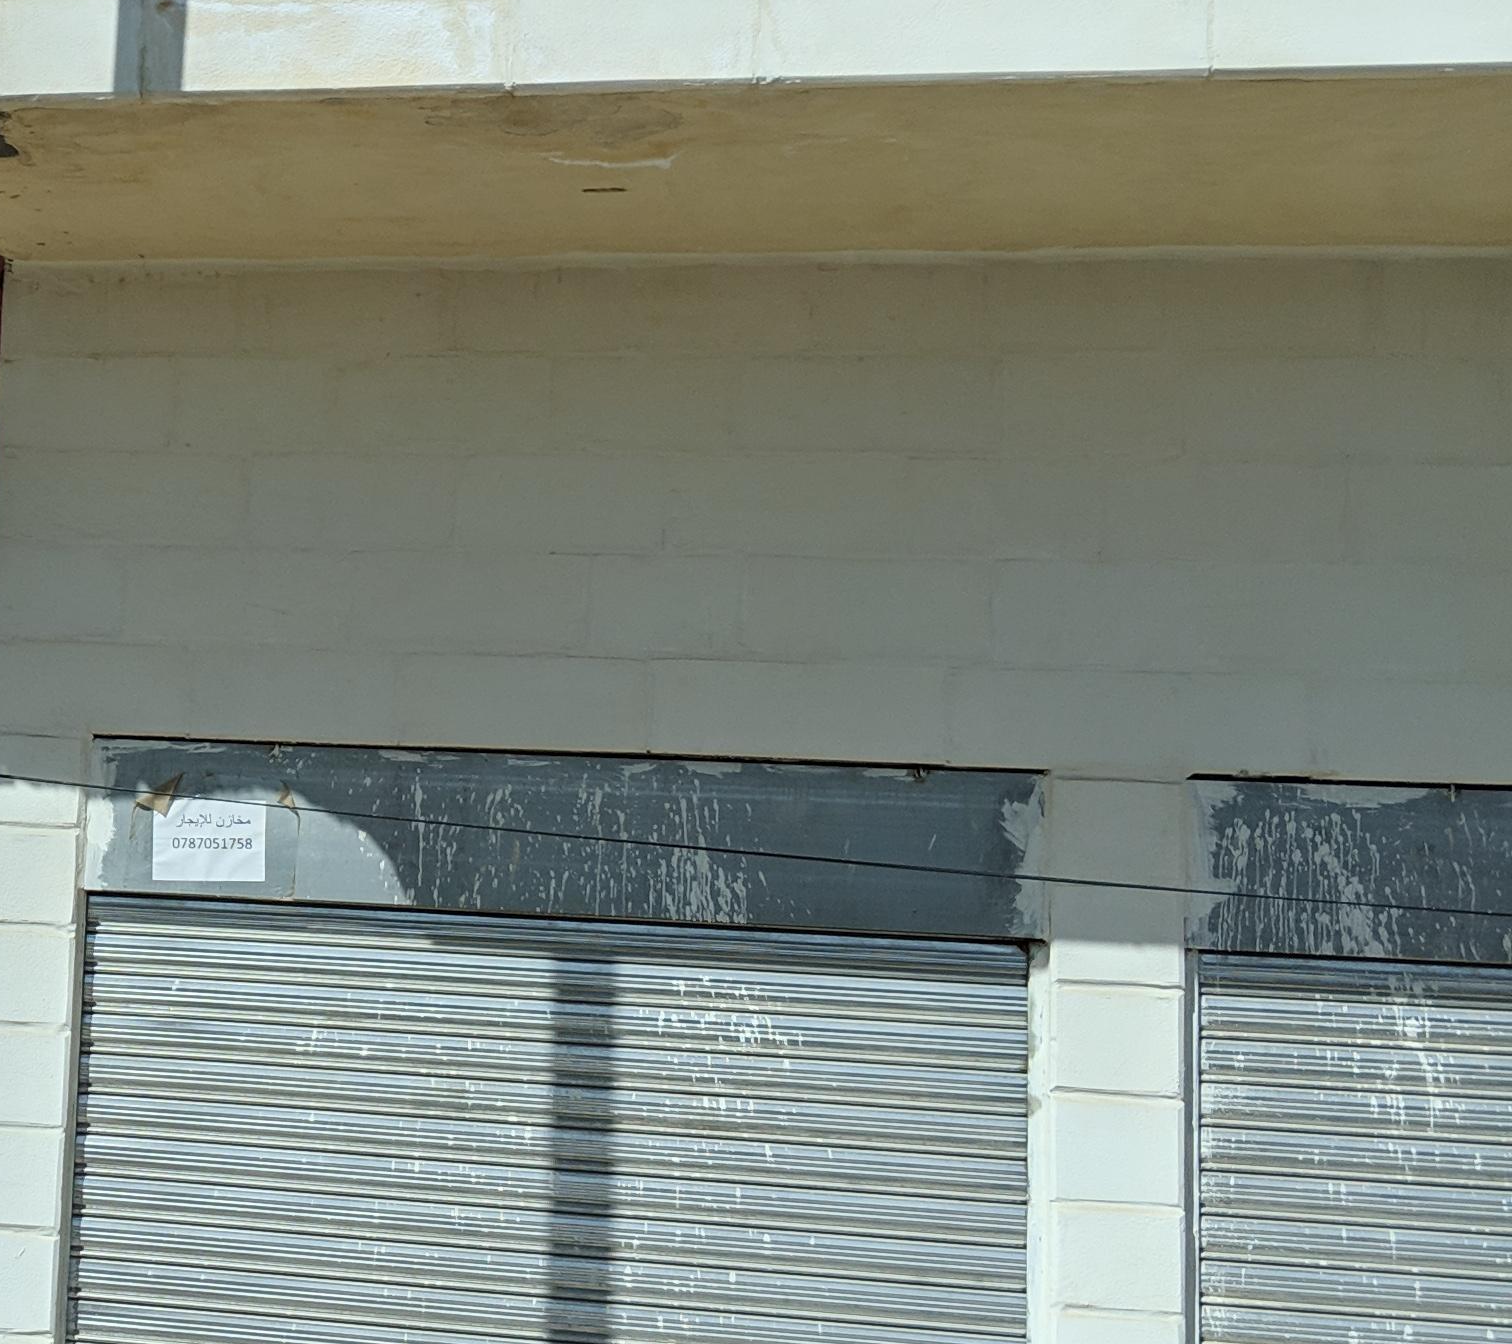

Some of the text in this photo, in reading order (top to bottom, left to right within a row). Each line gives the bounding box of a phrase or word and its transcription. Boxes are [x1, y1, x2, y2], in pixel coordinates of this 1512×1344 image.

[175, 813, 252, 828] مخازن للإيجار
[172, 837, 253, 850] 0787051758
